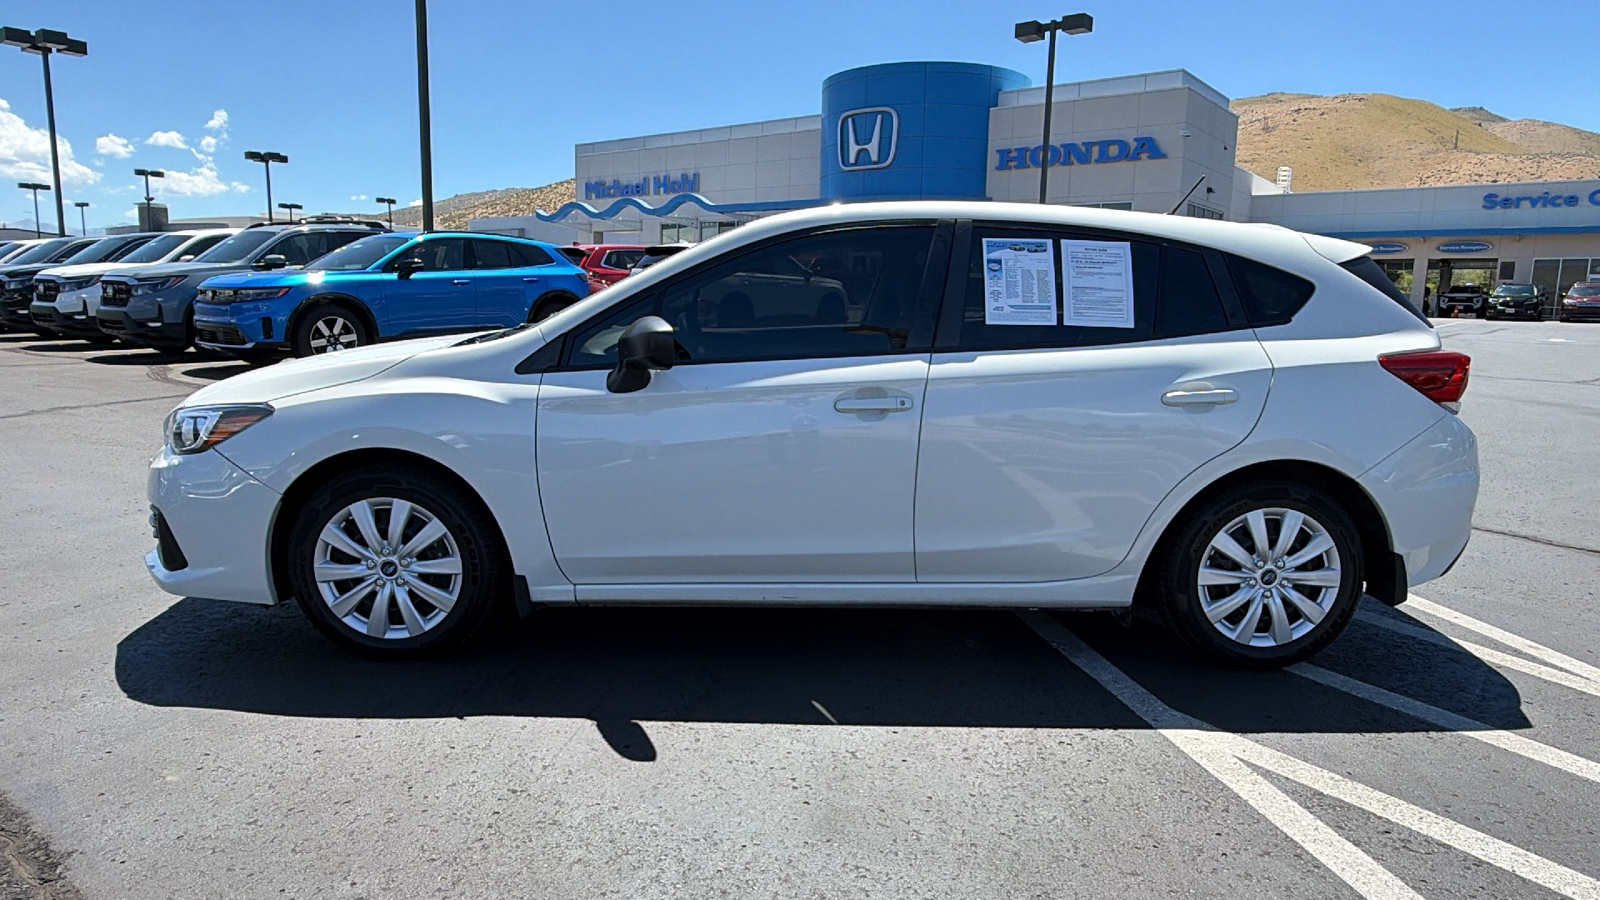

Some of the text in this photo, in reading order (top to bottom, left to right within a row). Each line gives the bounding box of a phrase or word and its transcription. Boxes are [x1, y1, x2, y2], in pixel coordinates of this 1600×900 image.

[995, 137, 1167, 170] HONDA
[584, 173, 698, 199] Michael Hohl
[1482, 190, 1579, 210] Service
